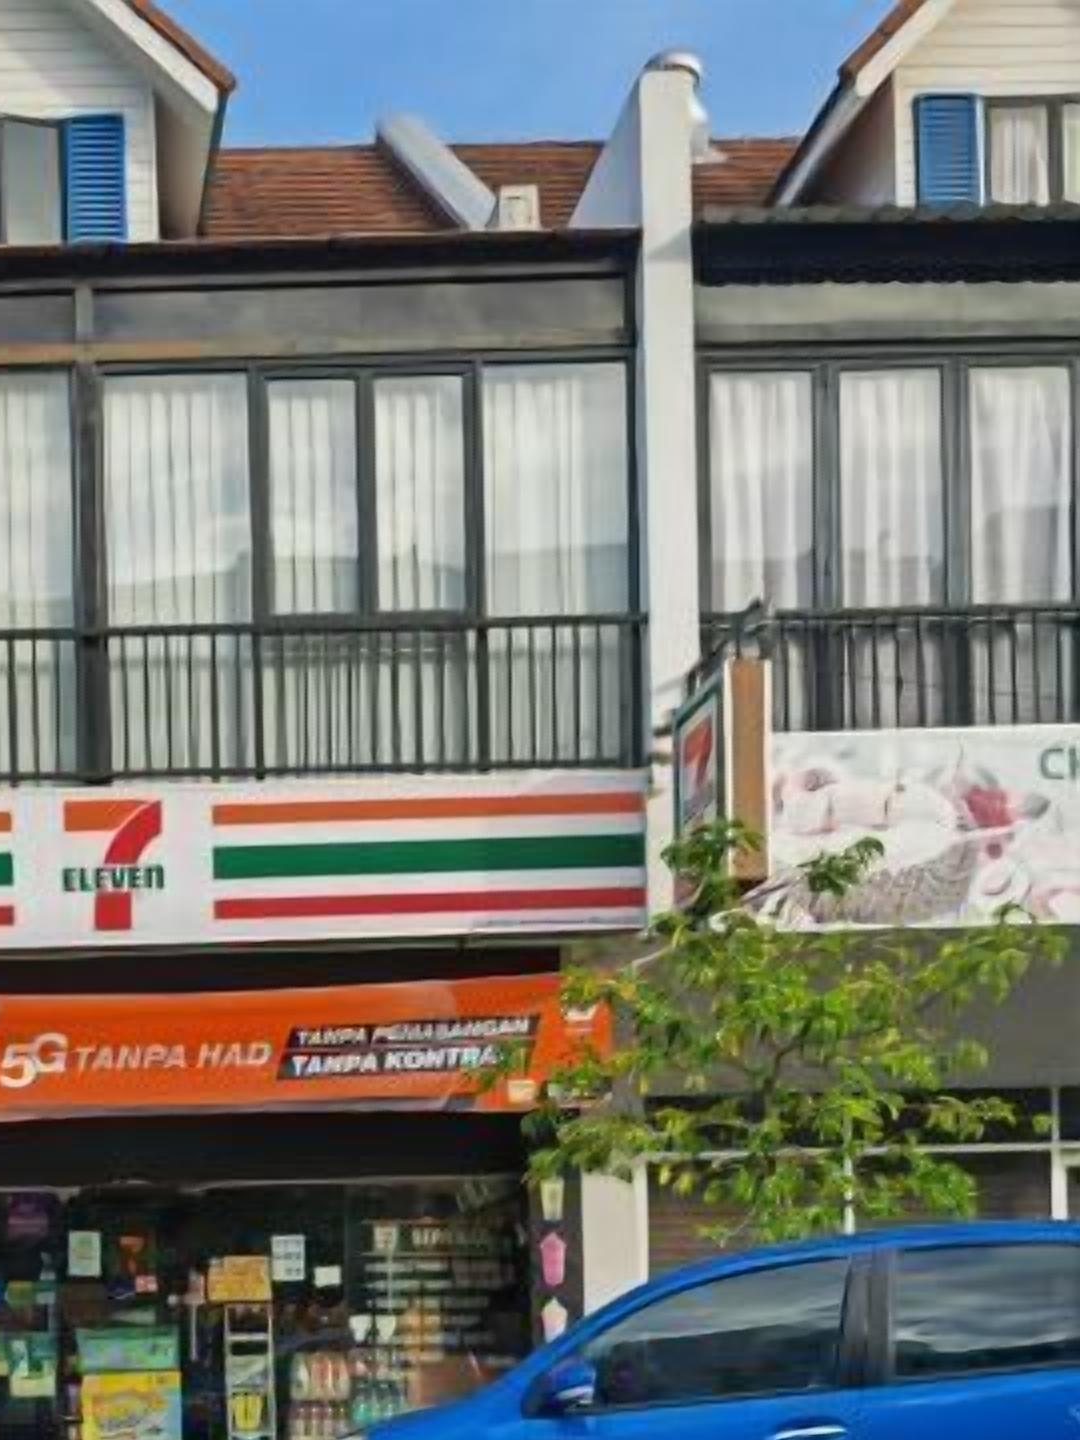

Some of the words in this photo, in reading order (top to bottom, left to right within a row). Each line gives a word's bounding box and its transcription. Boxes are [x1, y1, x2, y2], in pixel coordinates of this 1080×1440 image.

[64, 799, 162, 931] 7
[74, 1045, 187, 1071] TANPA
[195, 1041, 272, 1069] HAD
[291, 1053, 377, 1077] TANPA
[383, 1045, 512, 1072] KONTRA
